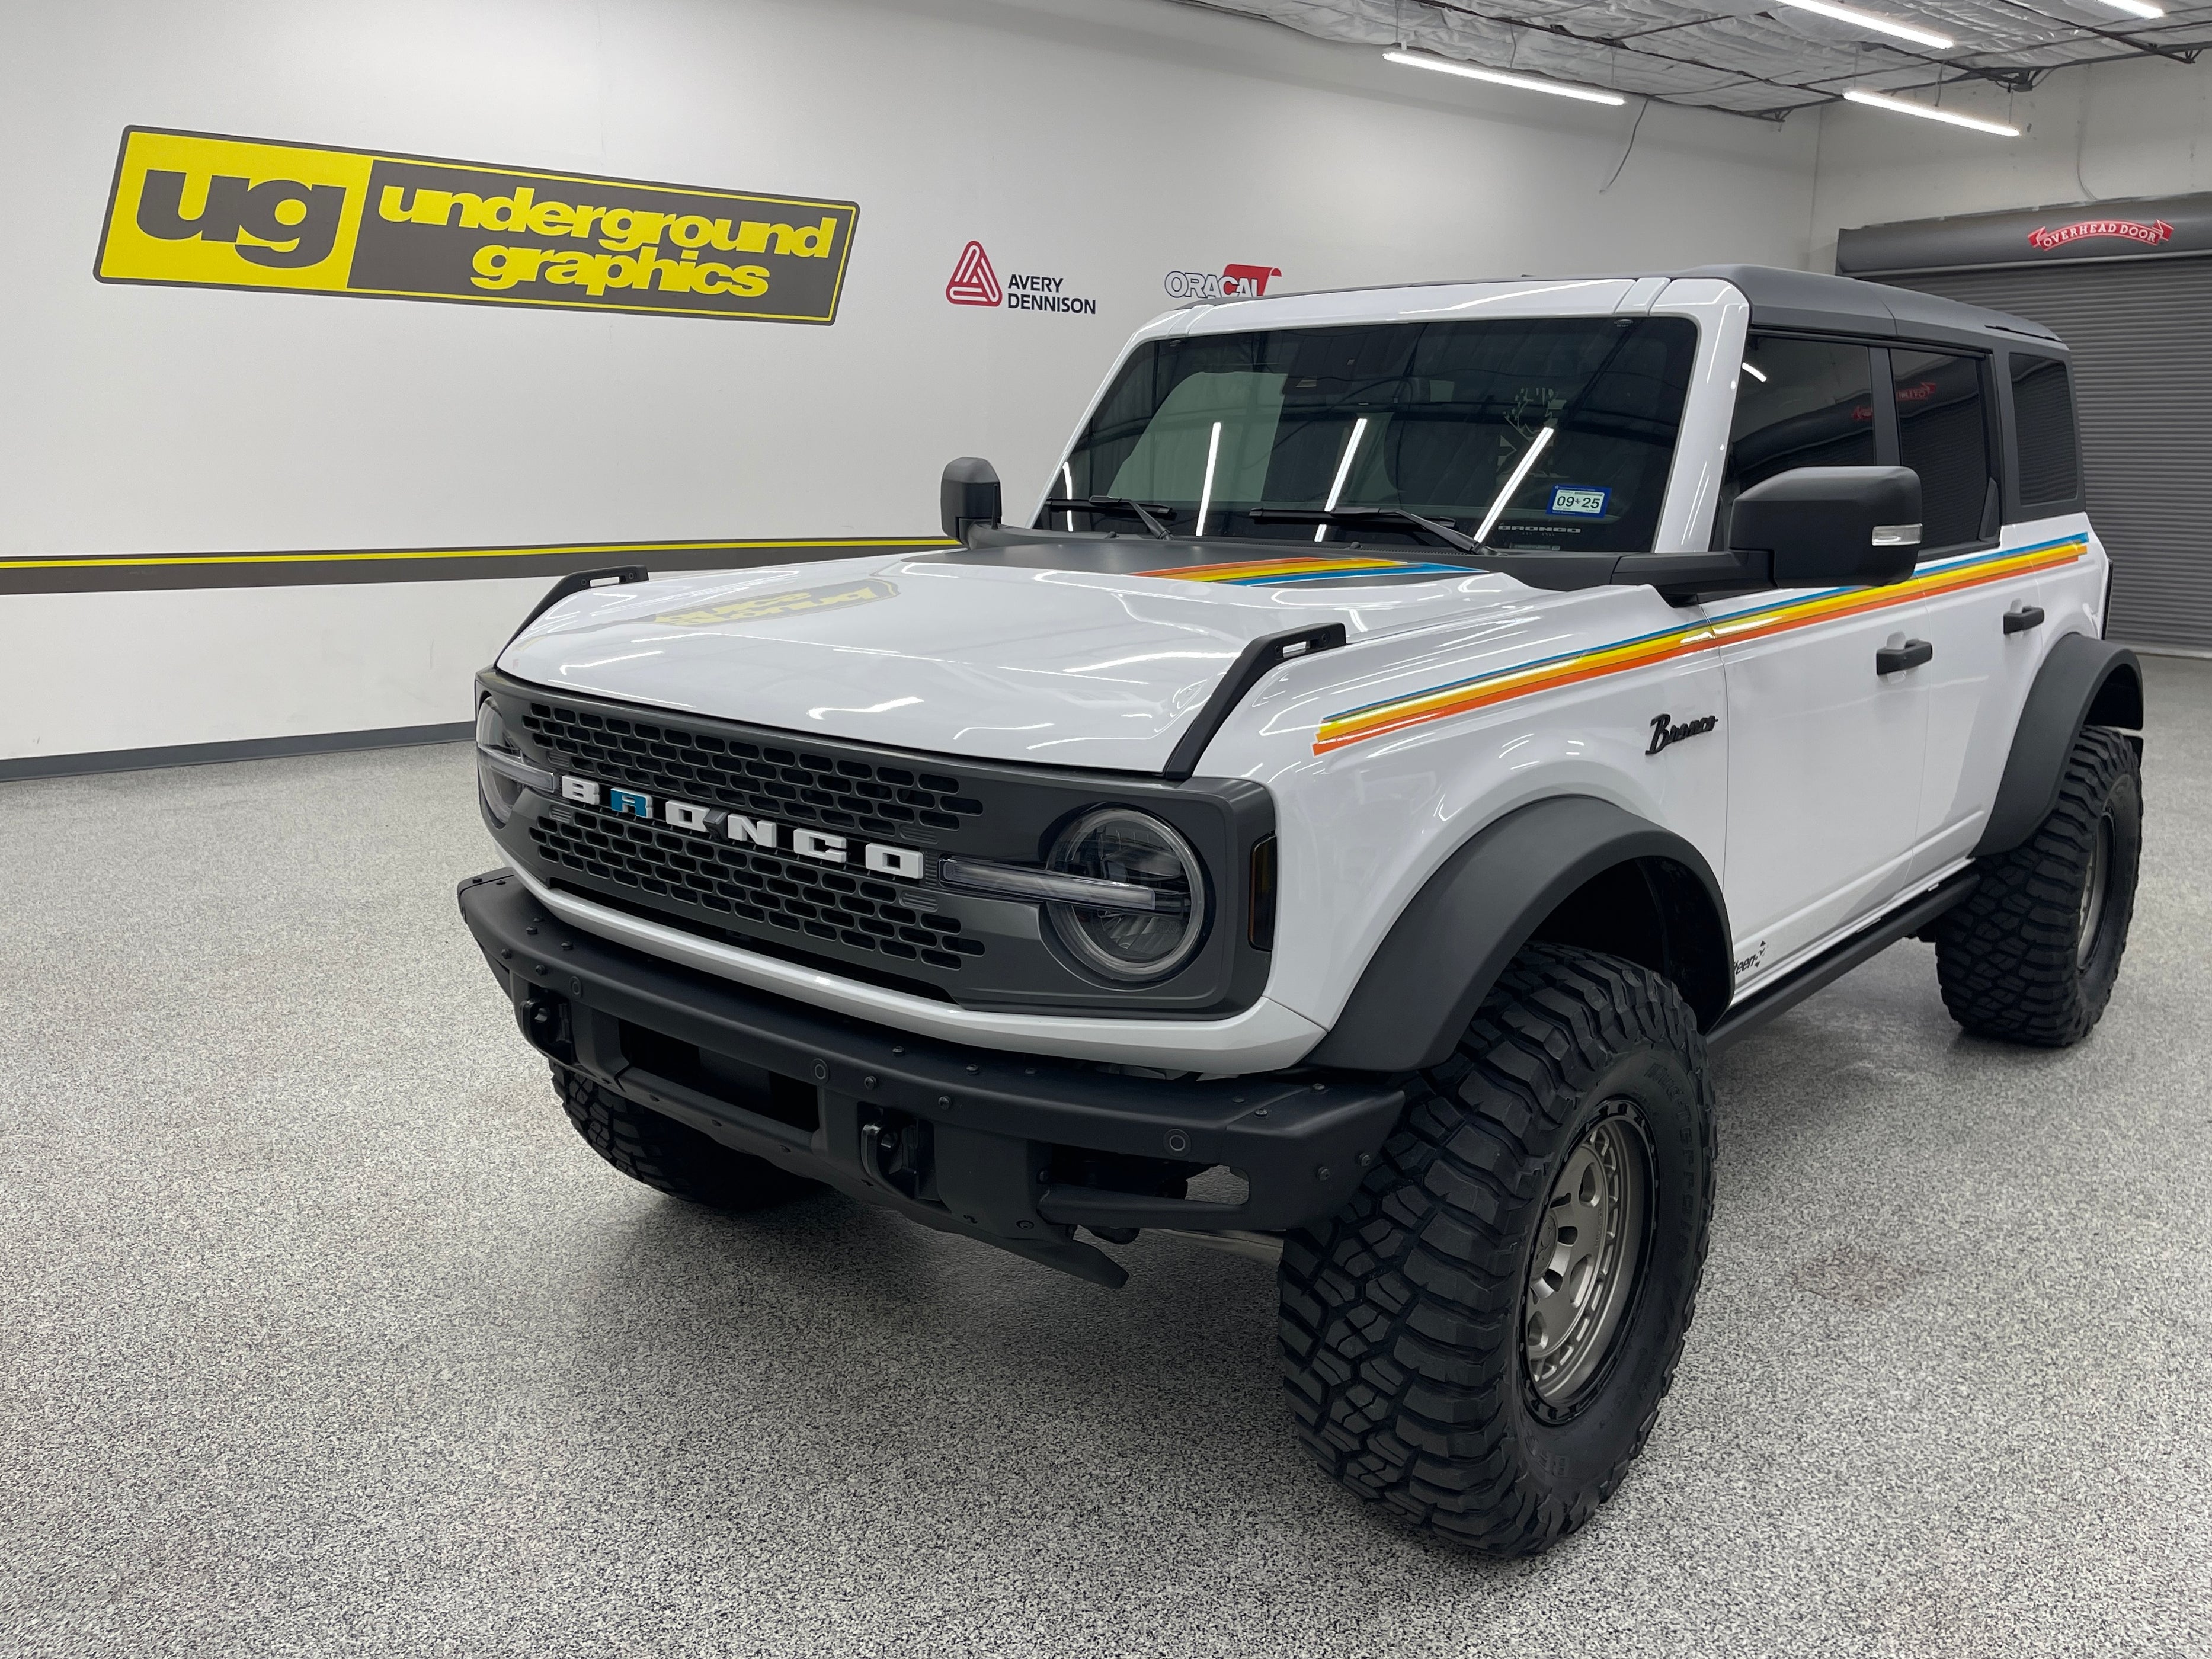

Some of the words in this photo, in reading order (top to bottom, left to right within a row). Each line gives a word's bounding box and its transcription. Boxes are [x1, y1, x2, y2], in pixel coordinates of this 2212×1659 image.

[136, 168, 347, 269] ug
[378, 185, 837, 258] underground
[2044, 223, 2117, 248] OVERHEAD
[2119, 223, 2156, 243] DOOR
[470, 244, 768, 297] graphics
[1007, 274, 1064, 293] AVERY
[1007, 293, 1096, 315] DENNISON
[1557, 495, 1575, 507] 09
[1581, 497, 1600, 509] 25
[1497, 525, 1581, 533] BRONCO
[1645, 713, 1719, 755] Bronco
[561, 773, 924, 880] BRONCO
